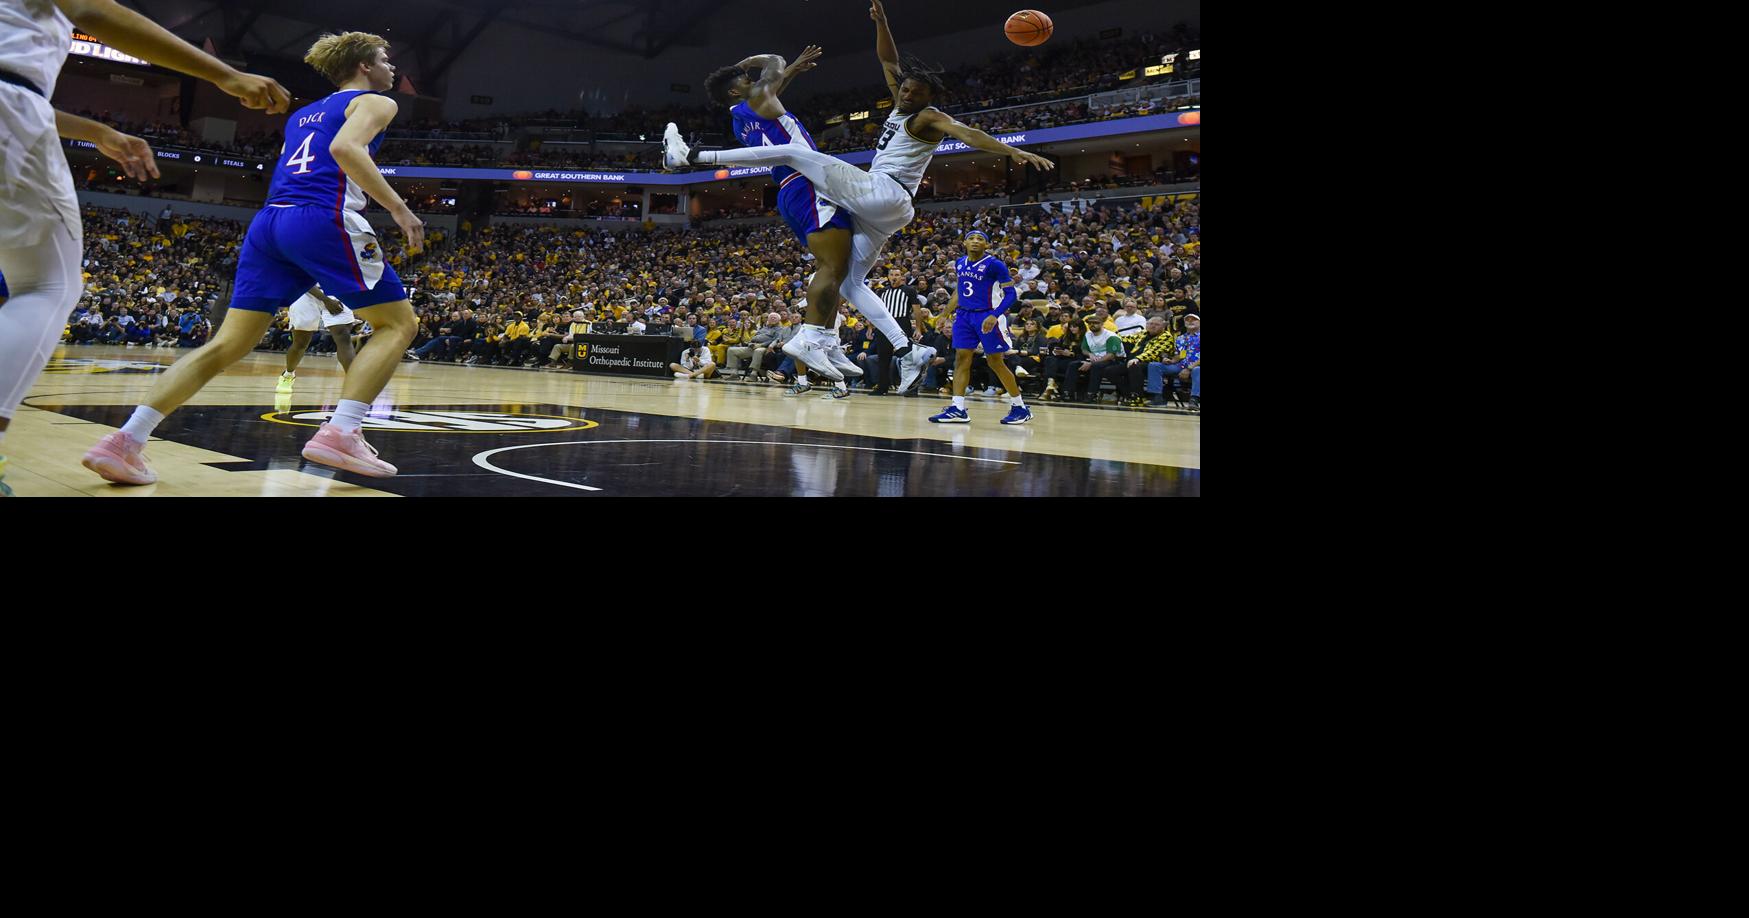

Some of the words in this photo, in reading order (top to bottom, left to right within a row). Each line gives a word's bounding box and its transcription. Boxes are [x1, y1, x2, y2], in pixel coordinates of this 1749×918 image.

[299, 112, 326, 127] DICK
[1000, 134, 1026, 144] BANK
[77, 141, 97, 149] TURN
[157, 151, 180, 159] BLOCKS
[285, 131, 316, 175] 4
[223, 159, 244, 167] STEALS
[730, 168, 749, 176] GREAT
[560, 173, 601, 181] SOUTHERN
[963, 281, 974, 297] 3
[591, 345, 620, 354] Missouri
[589, 356, 631, 367] Orthopaedic
[632, 358, 664, 368] Institute
